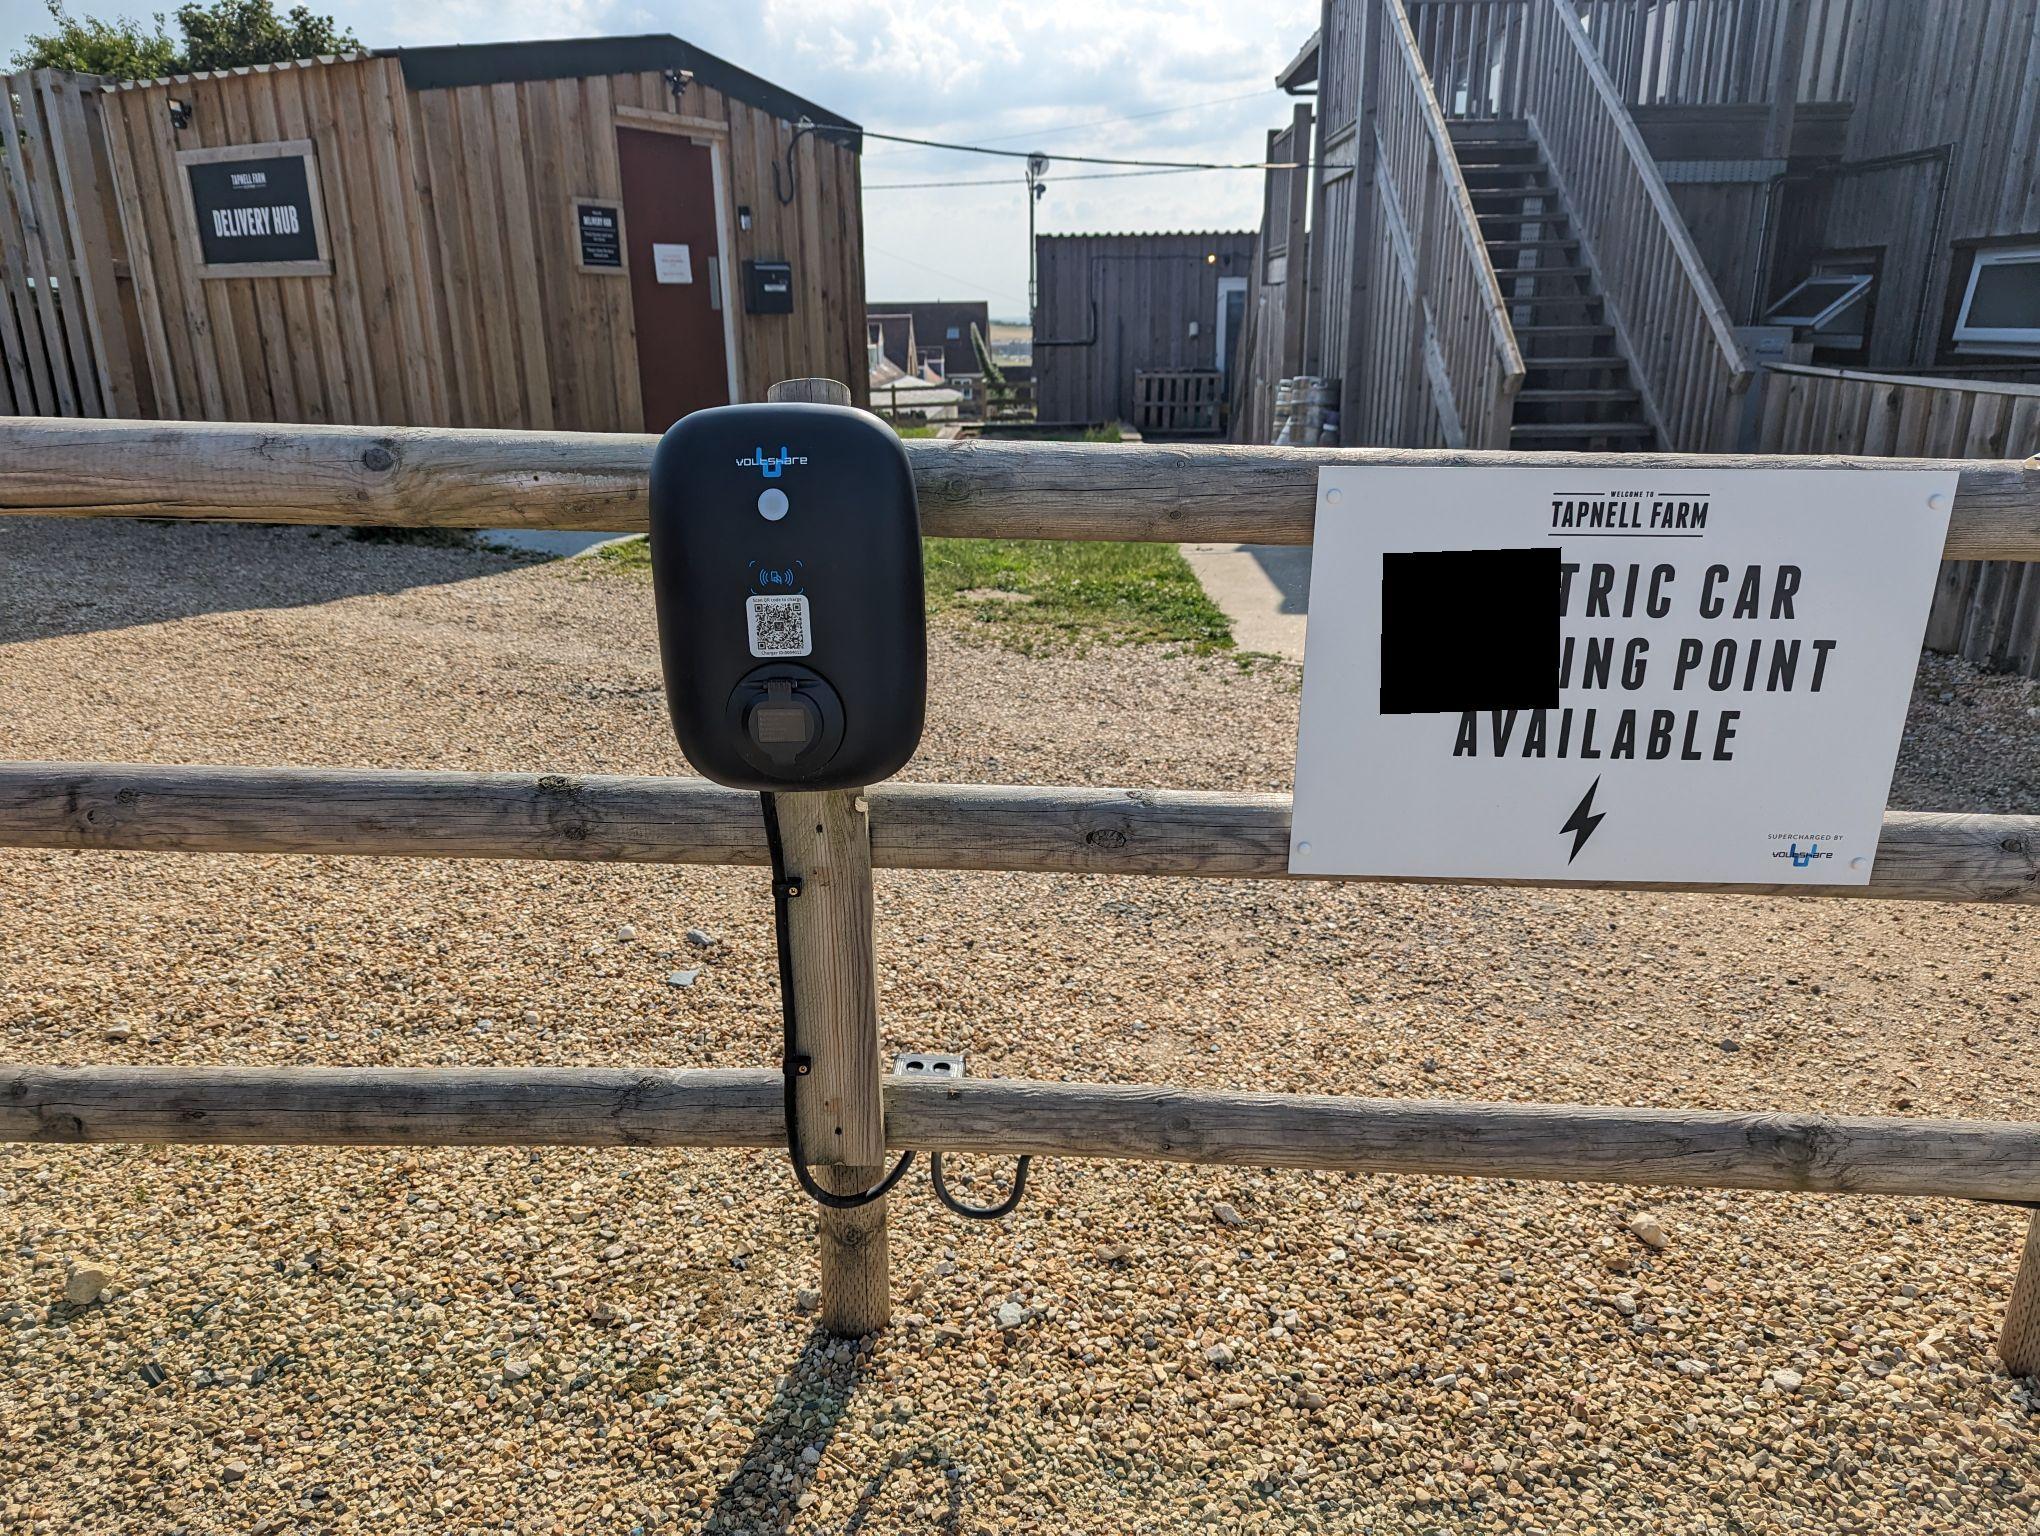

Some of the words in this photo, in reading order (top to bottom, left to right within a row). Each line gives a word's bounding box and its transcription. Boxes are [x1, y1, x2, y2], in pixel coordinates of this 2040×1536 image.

[231, 173, 252, 185] TAPNELL
[252, 172, 266, 184] FARM
[212, 207, 271, 237] DELIVERY
[272, 205, 299, 235] HUB
[1552, 501, 1642, 528] TAPNELL
[1649, 502, 1709, 529] FARM
[1699, 564, 1802, 620] CAR
[1673, 638, 1837, 692] POINT
[1452, 708, 1741, 761] AVAILABLE
[1767, 833, 1831, 841] SUPERCHARGED
